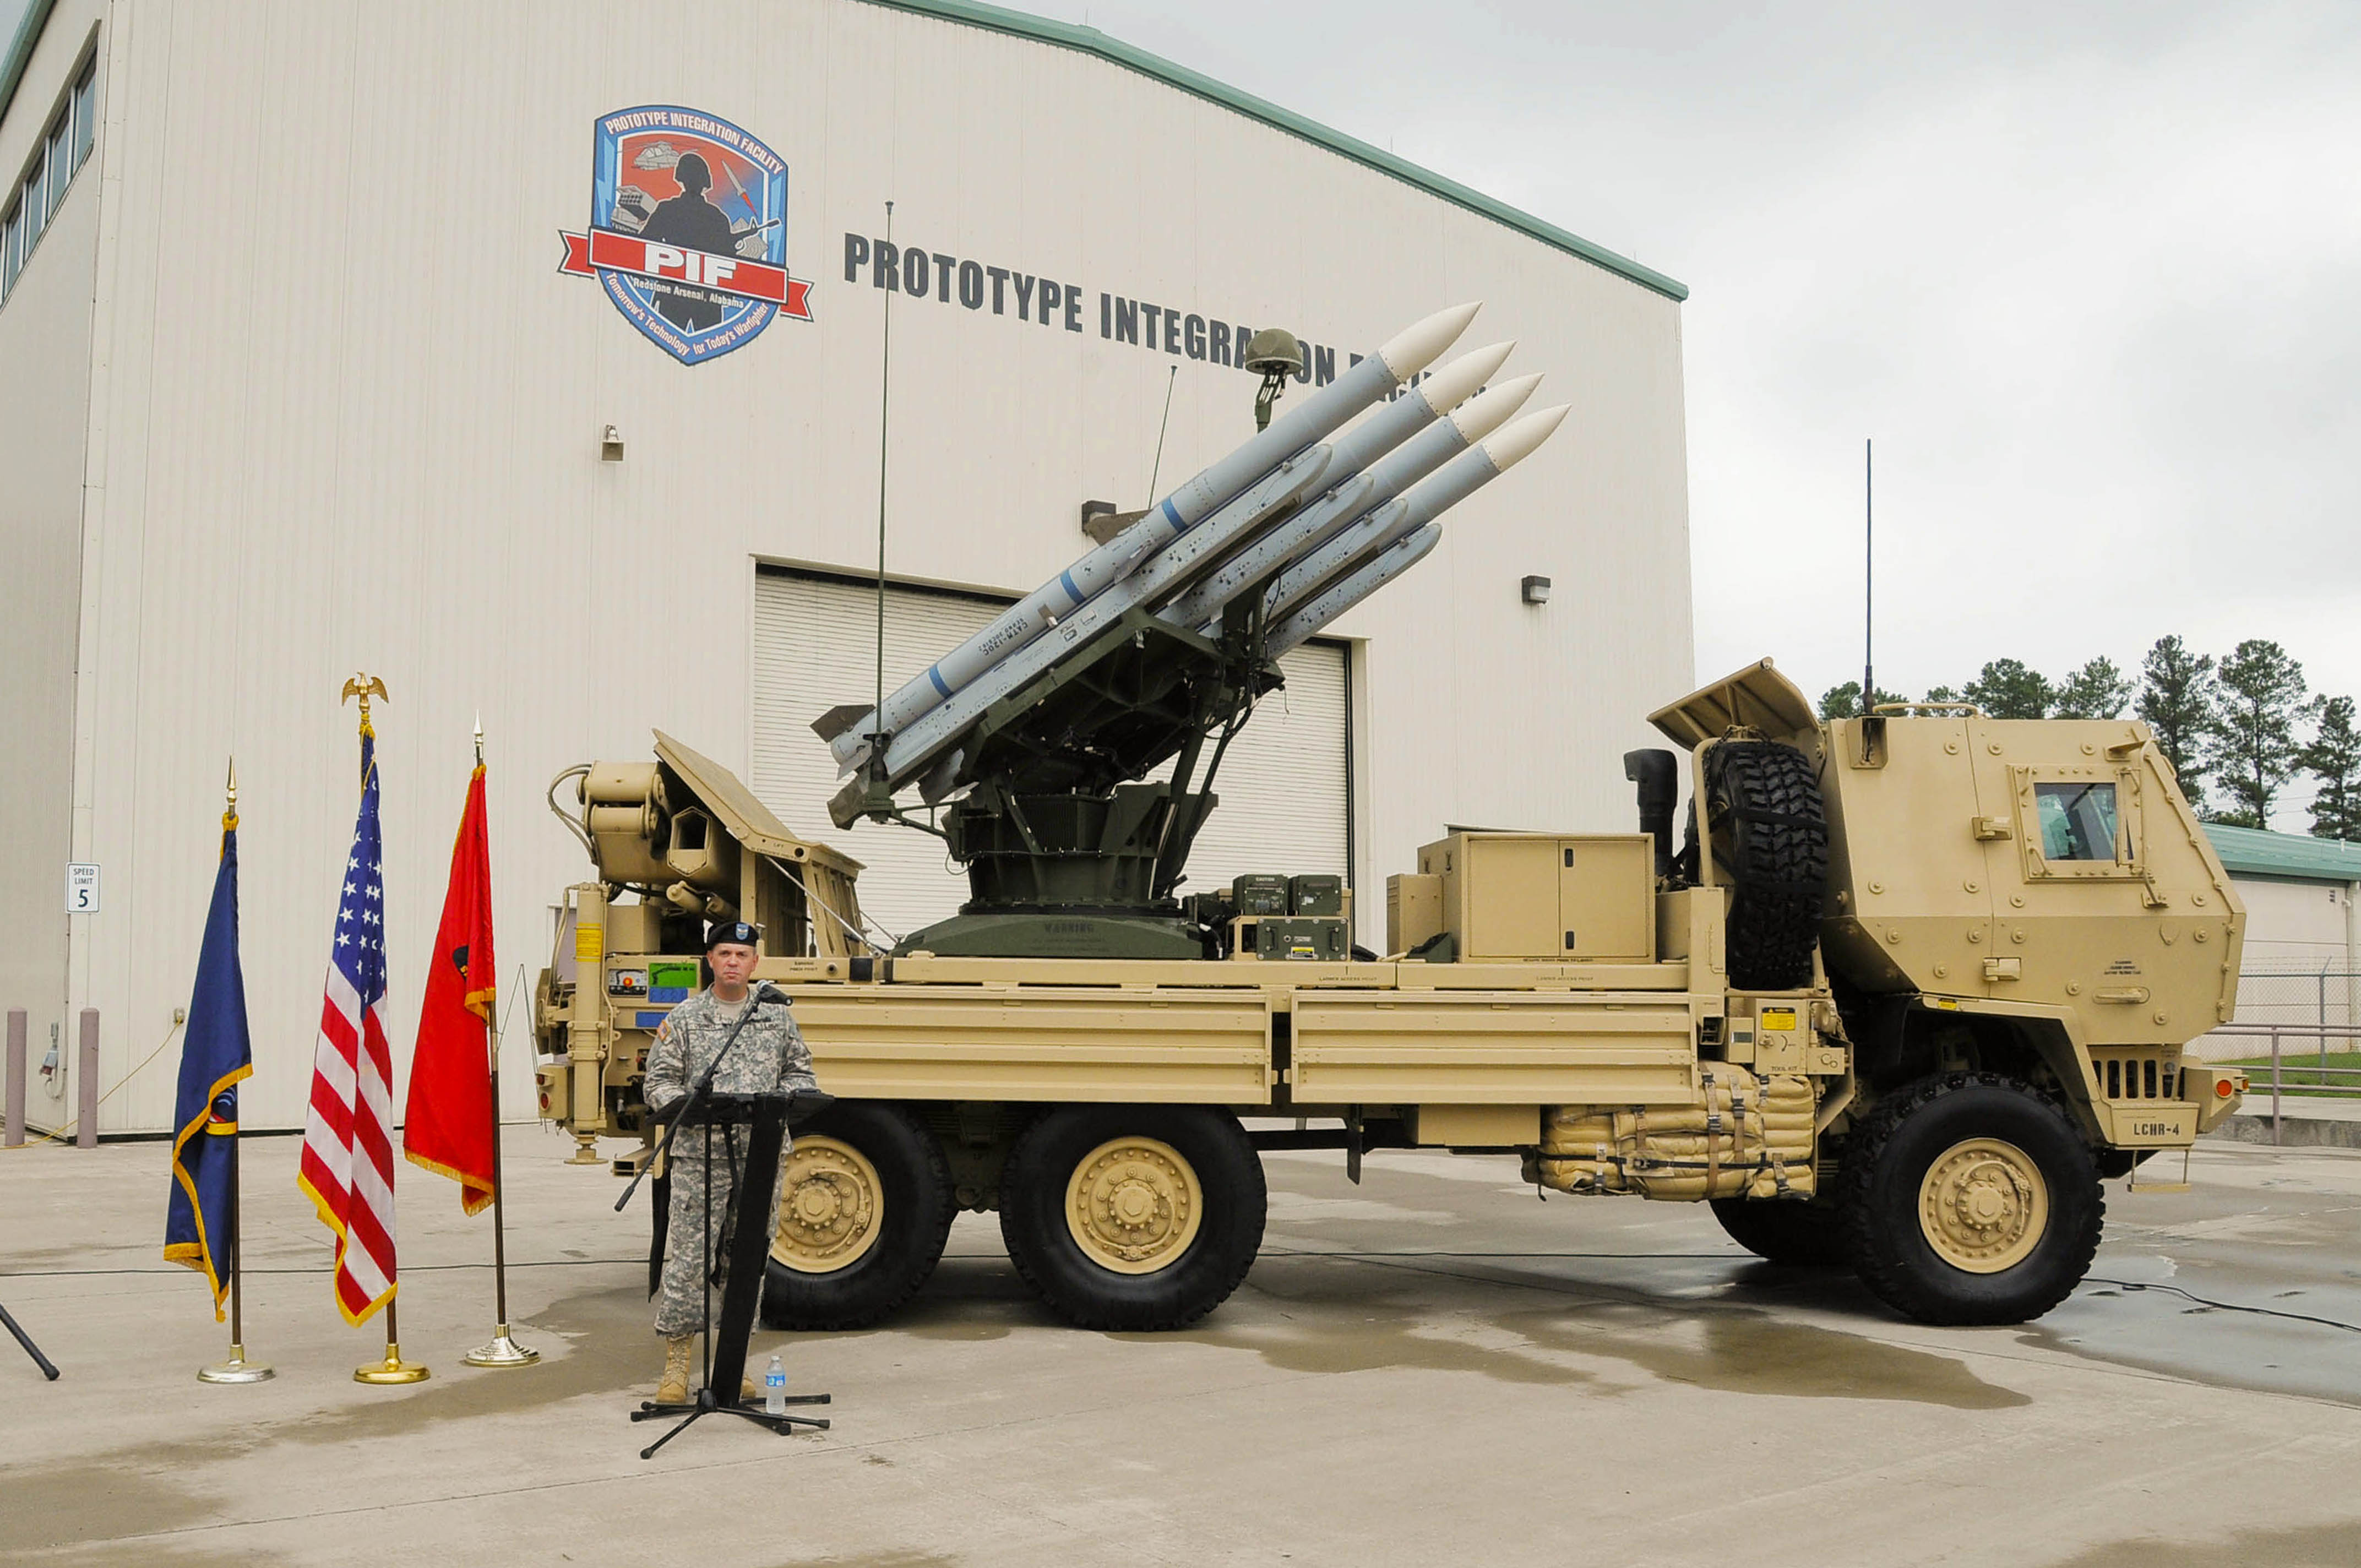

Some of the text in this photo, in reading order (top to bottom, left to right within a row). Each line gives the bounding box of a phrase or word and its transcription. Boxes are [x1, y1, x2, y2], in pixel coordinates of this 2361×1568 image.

[606, 112, 785, 175] PROTOTYPE INTEGRATION FACILITY
[645, 243, 737, 286] PIF
[844, 232, 1082, 333] PROTOTYPE
[606, 273, 689, 356] Tomorrow's Technology
[633, 277, 671, 295] Redstone
[709, 292, 744, 309] Alabama
[693, 302, 769, 355] for Today's Warfighter
[78, 889, 88, 907] 5
[2134, 1123, 2179, 1135] LCHR-4
